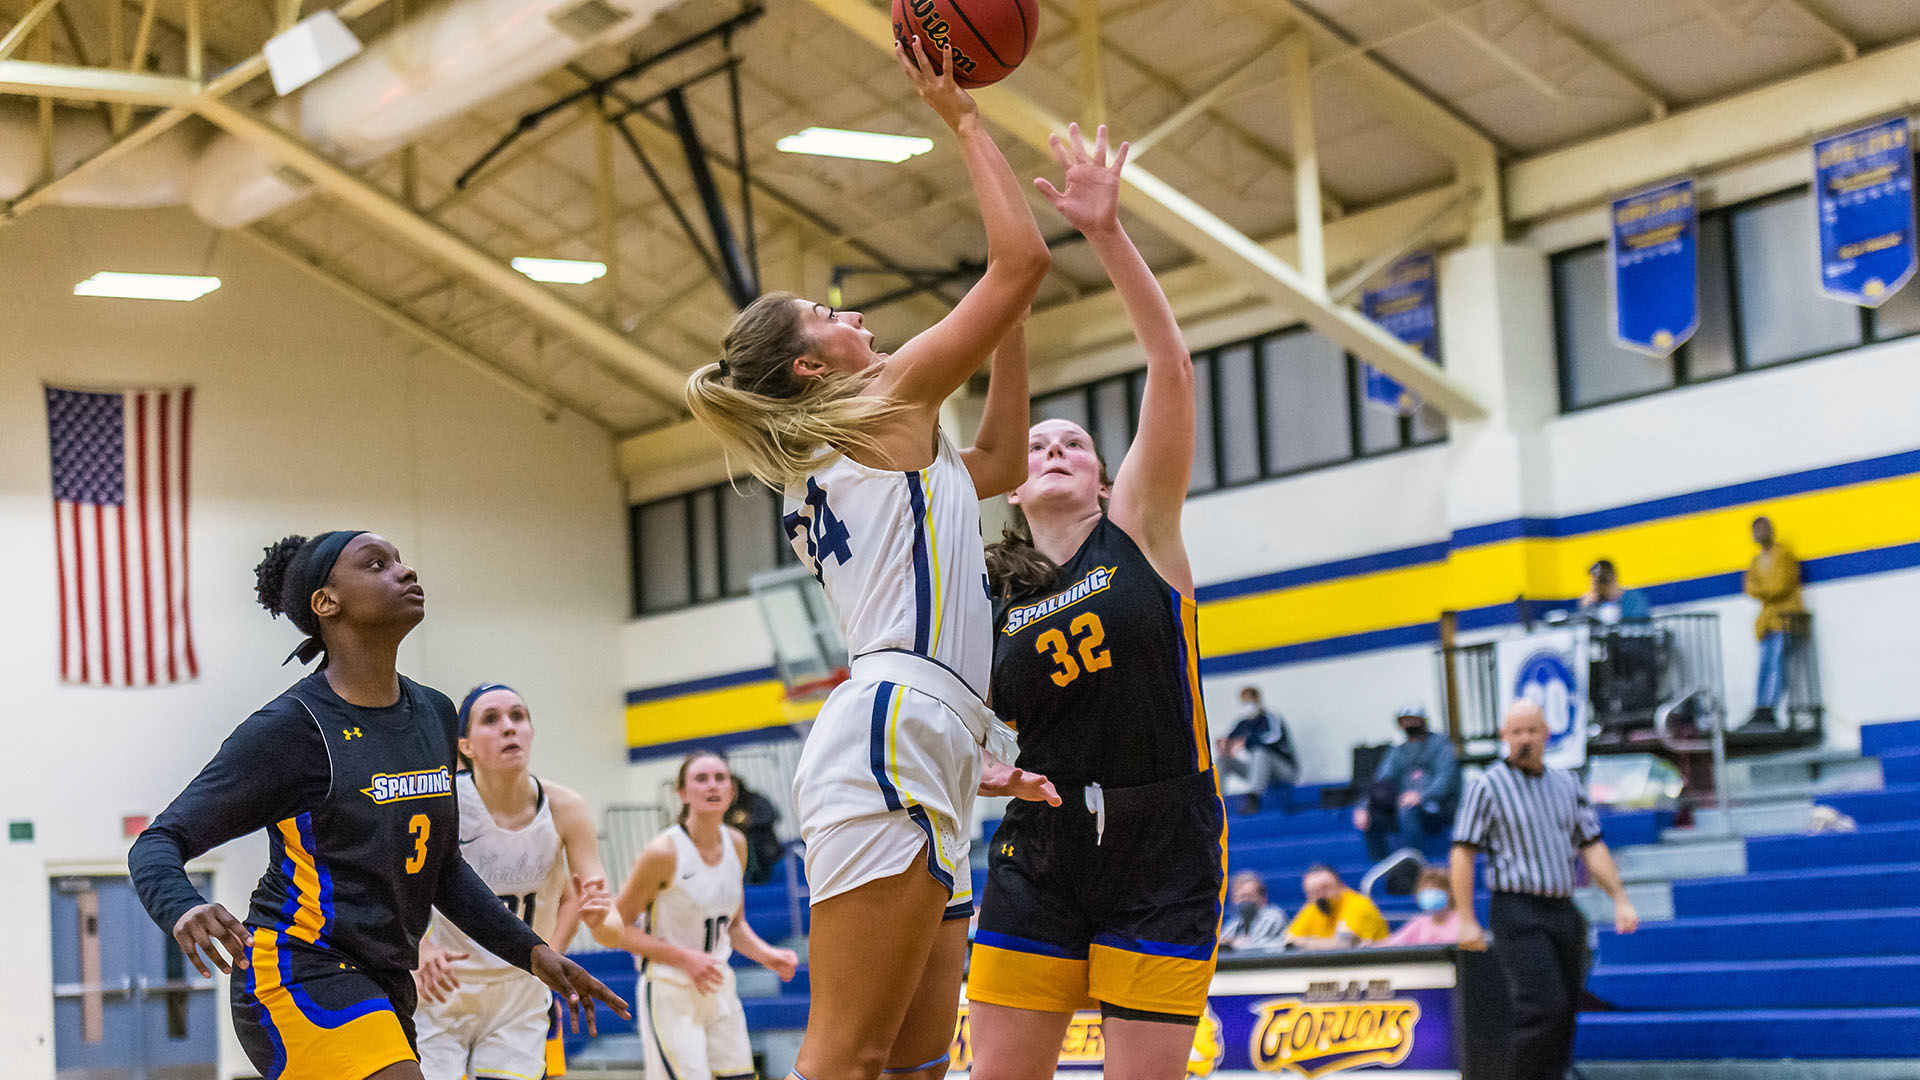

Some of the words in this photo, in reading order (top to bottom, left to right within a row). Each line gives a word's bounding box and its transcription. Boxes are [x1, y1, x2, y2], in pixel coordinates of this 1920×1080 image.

[1005, 567, 1110, 635] SPALDING
[1036, 612, 1112, 687] 32
[371, 767, 452, 802] SPALDING
[406, 814, 430, 874] 3
